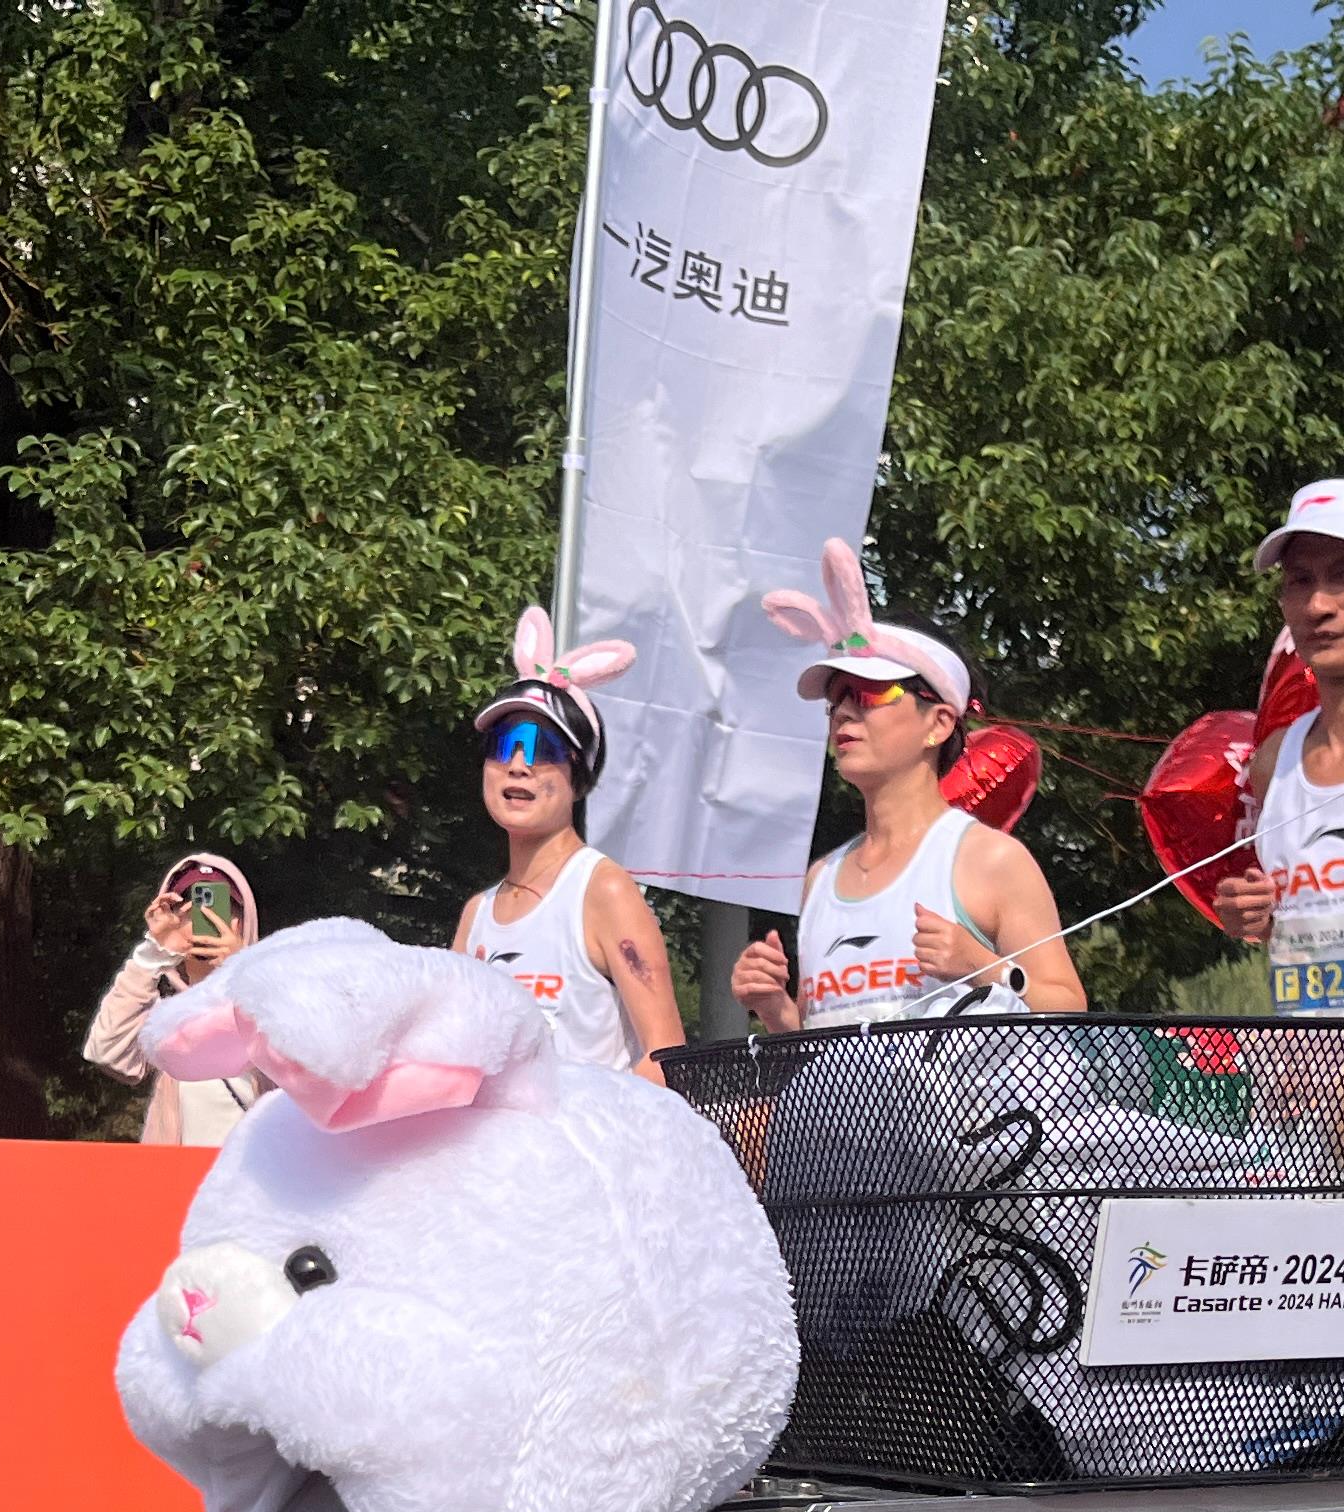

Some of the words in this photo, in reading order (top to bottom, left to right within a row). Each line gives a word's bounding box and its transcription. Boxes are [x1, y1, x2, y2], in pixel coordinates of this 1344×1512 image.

[602, 221, 790, 327] 一汽奥迪
[1172, 1295, 1263, 1313] Casarte
